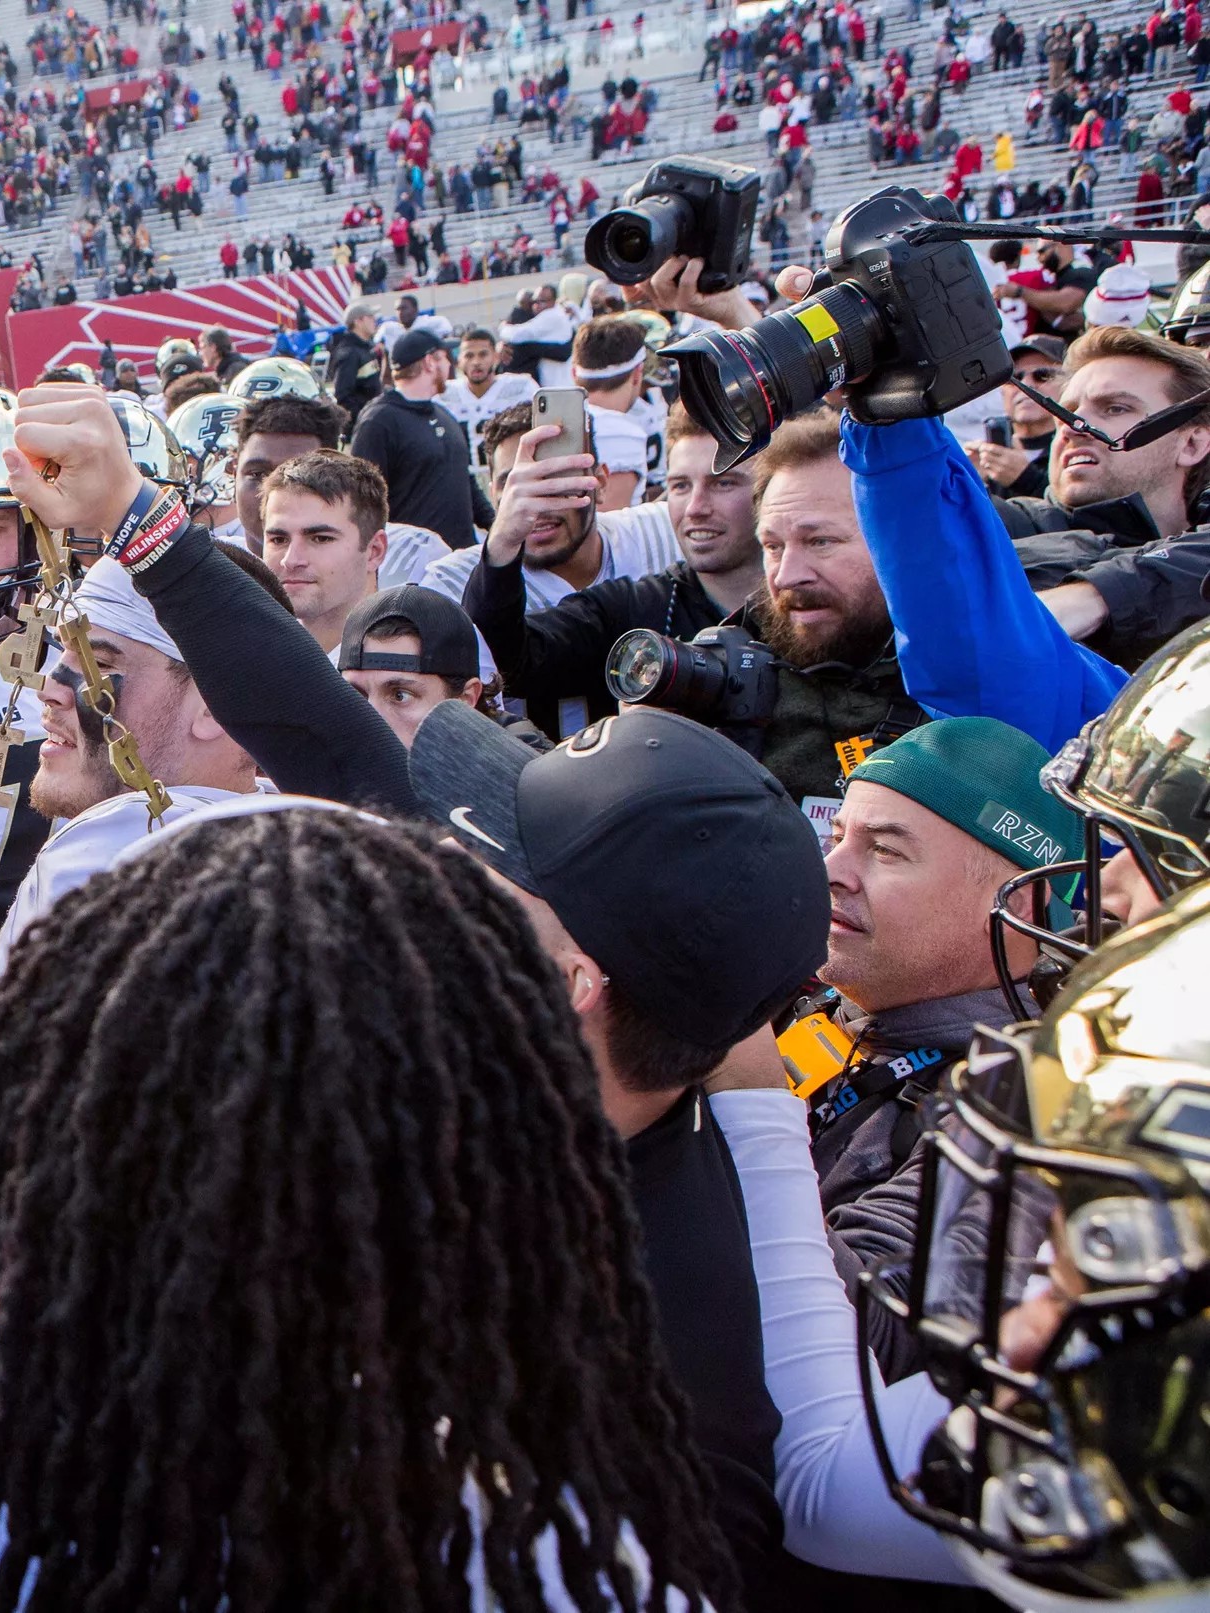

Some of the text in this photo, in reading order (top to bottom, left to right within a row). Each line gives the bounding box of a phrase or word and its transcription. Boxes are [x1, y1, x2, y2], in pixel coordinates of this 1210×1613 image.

[114, 512, 140, 547] HOPE
[138, 500, 172, 534] PURDUE
[125, 514, 180, 561] HILINSKI'S
[131, 538, 174, 575] FOOTBALL
[809, 803, 842, 820] IND
[991, 810, 1062, 867] RZN
